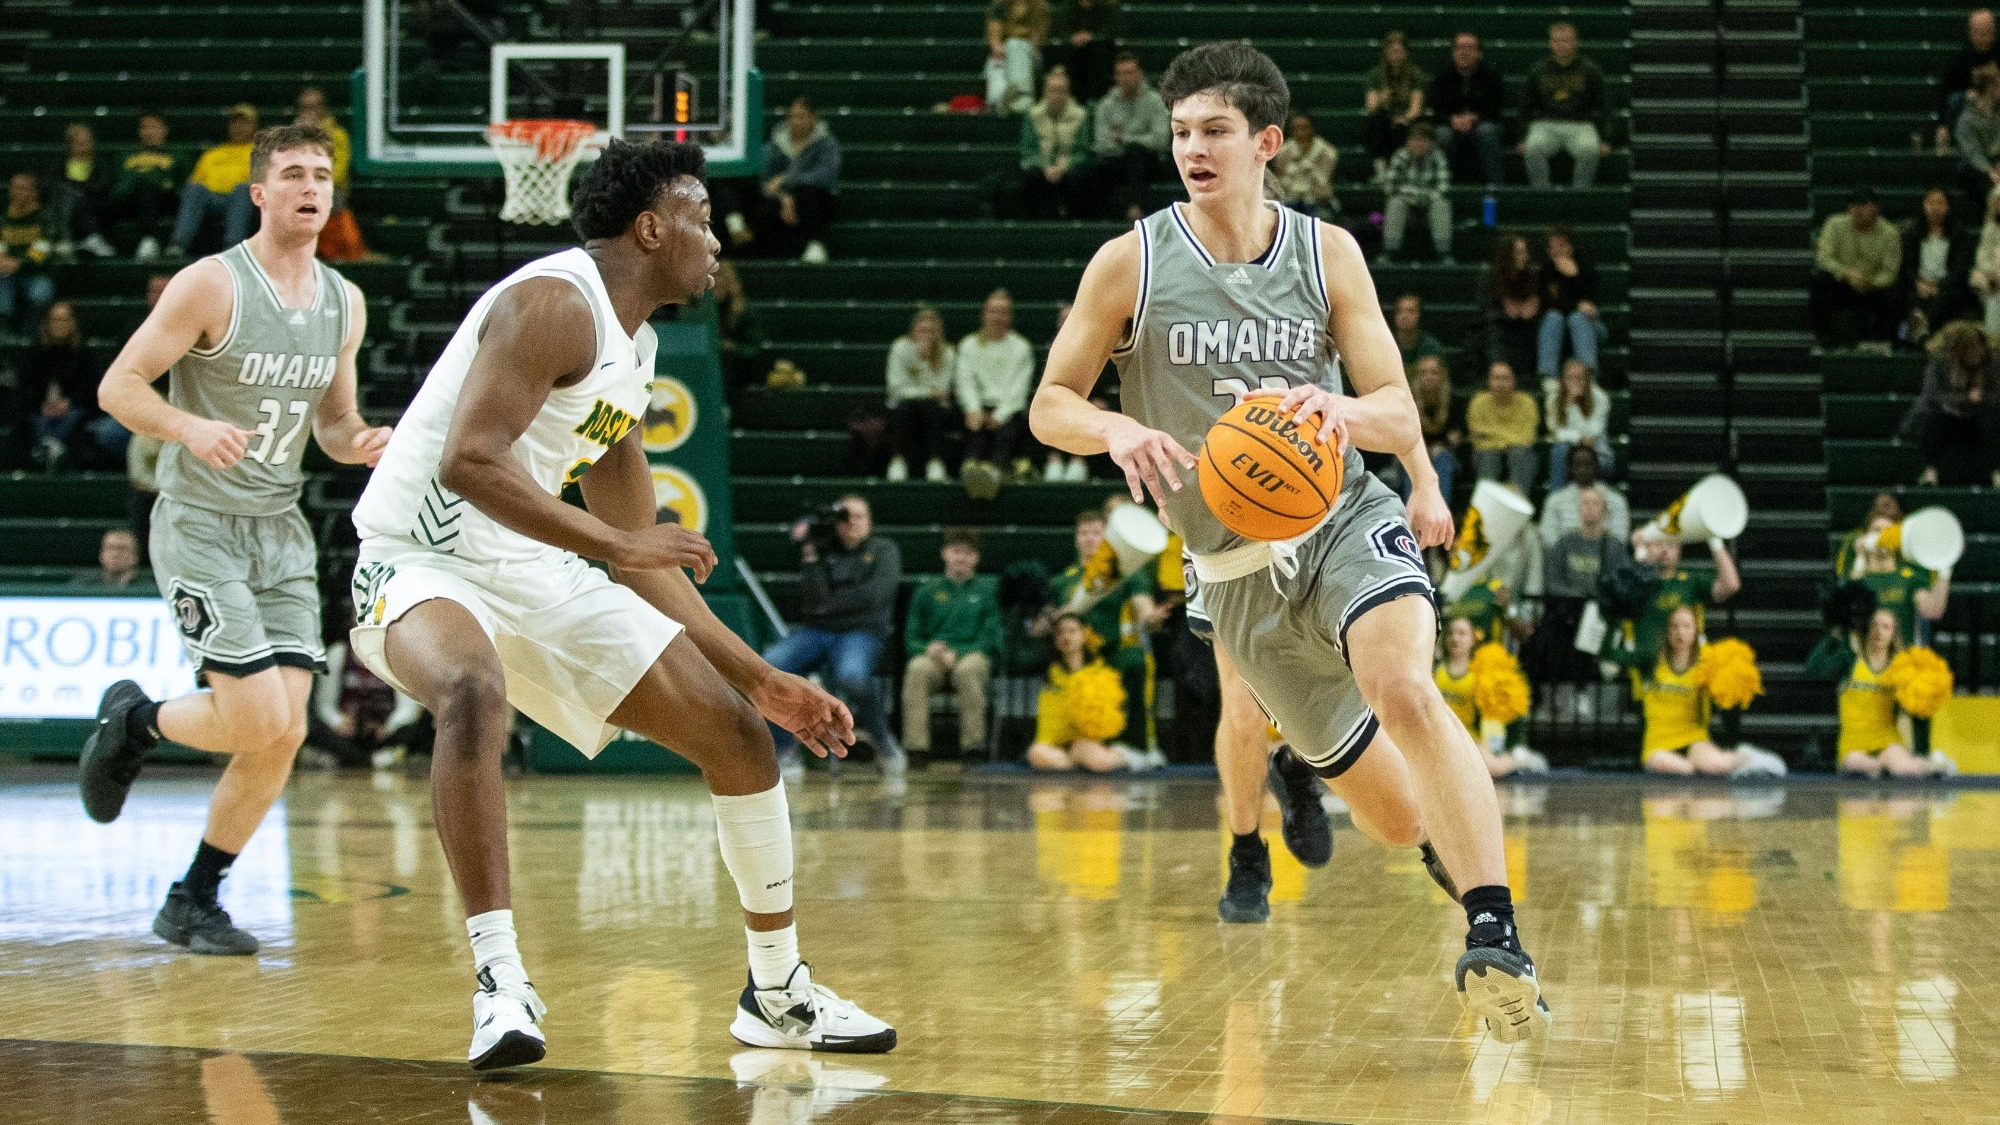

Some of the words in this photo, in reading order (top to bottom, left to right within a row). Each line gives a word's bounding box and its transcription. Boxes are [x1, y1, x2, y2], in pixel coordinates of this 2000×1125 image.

[1168, 318, 1316, 366] OMAHA
[238, 352, 337, 389] OMAHA
[245, 398, 309, 466] 32
[1244, 406, 1324, 477] Wilson
[1230, 452, 1286, 493] EVO
[0, 616, 187, 671] ROBI
